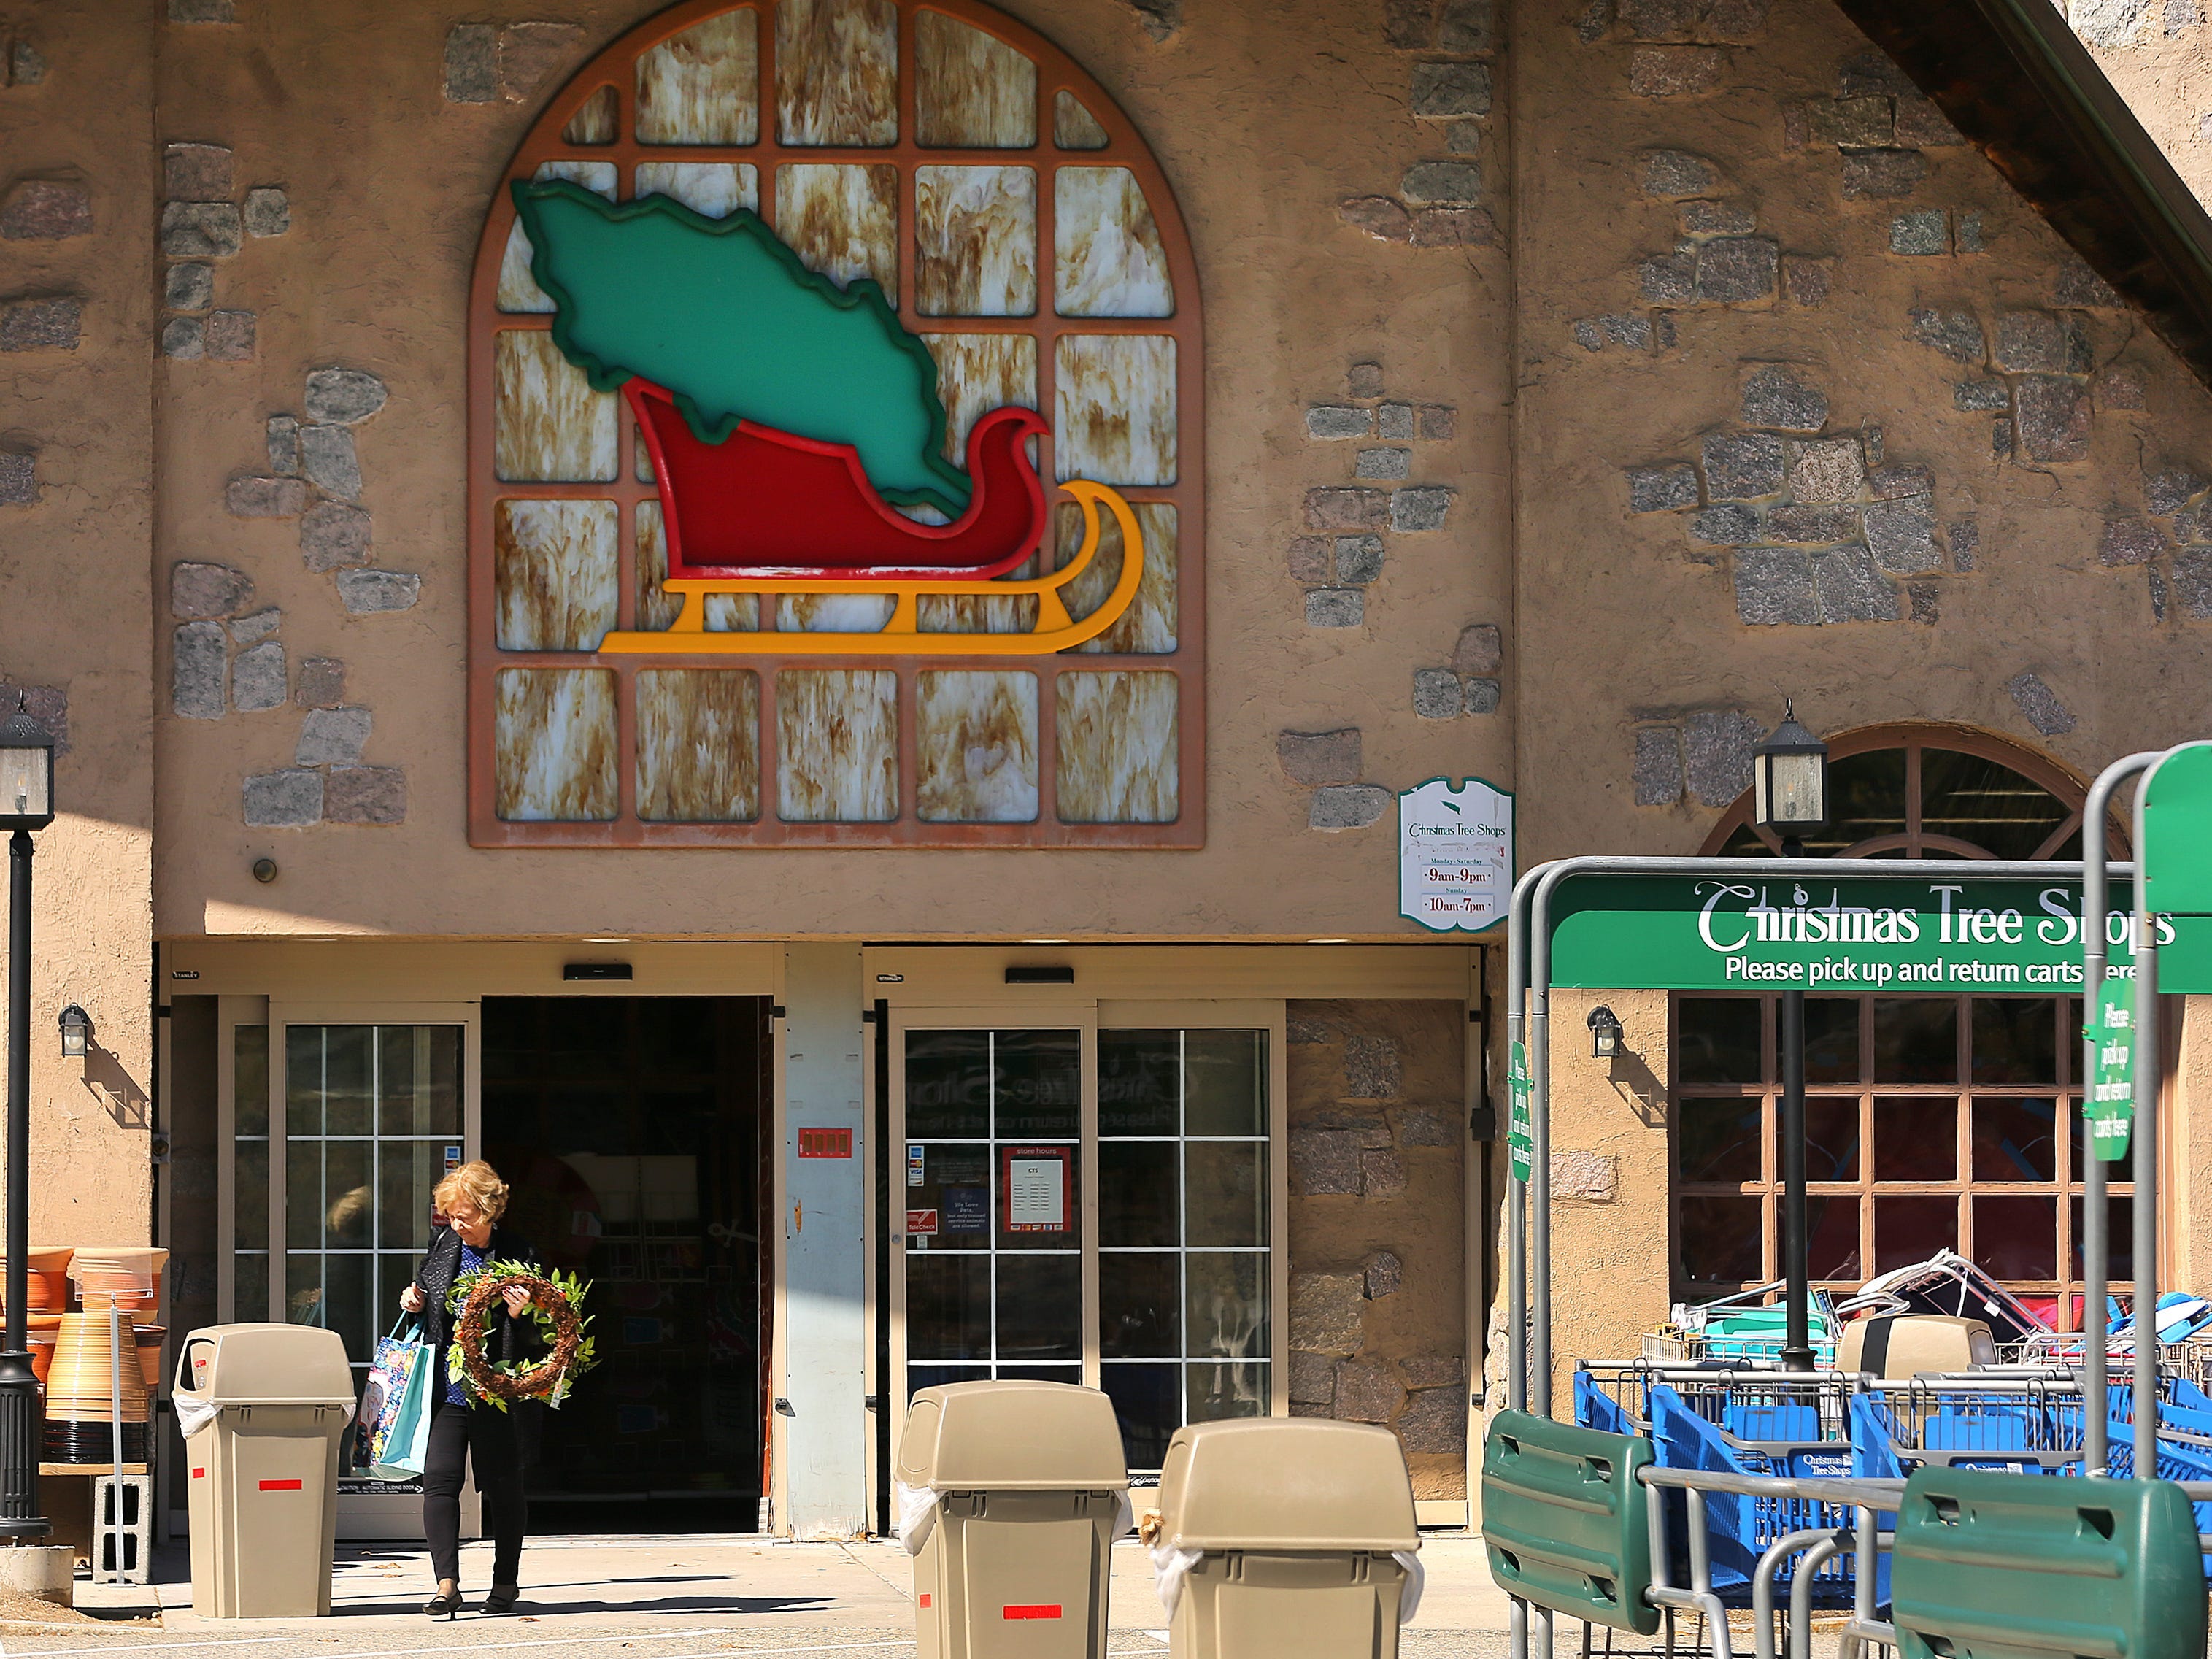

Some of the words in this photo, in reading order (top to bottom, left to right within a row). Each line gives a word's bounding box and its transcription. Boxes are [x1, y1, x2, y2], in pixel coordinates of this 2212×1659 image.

[1409, 823, 1454, 837] Christmas
[1456, 823, 1475, 836] Tree
[1477, 823, 1506, 838] Shops
[1695, 880, 1921, 952] Christmas
[1929, 885, 2023, 944] Tree
[1725, 955, 1803, 981] Please
[1809, 956, 1859, 987] pick
[1862, 962, 1893, 988] up
[1898, 957, 1943, 982] and
[1949, 960, 2019, 982] return
[2024, 961, 2085, 982] carts
[2106, 963, 2137, 980] ere
[2103, 1001, 2130, 1029] Please
[2100, 1038, 2118, 1071] pick
[2117, 1045, 2130, 1071] up
[2095, 1074, 2112, 1102] and
[2111, 1078, 2131, 1101] return
[2094, 1115, 2112, 1139] carts
[2111, 1110, 2129, 1137] here
[1803, 1454, 1843, 1466] Christmas
[1811, 1465, 1828, 1475] Tree
[1827, 1464, 1851, 1477] Shops
